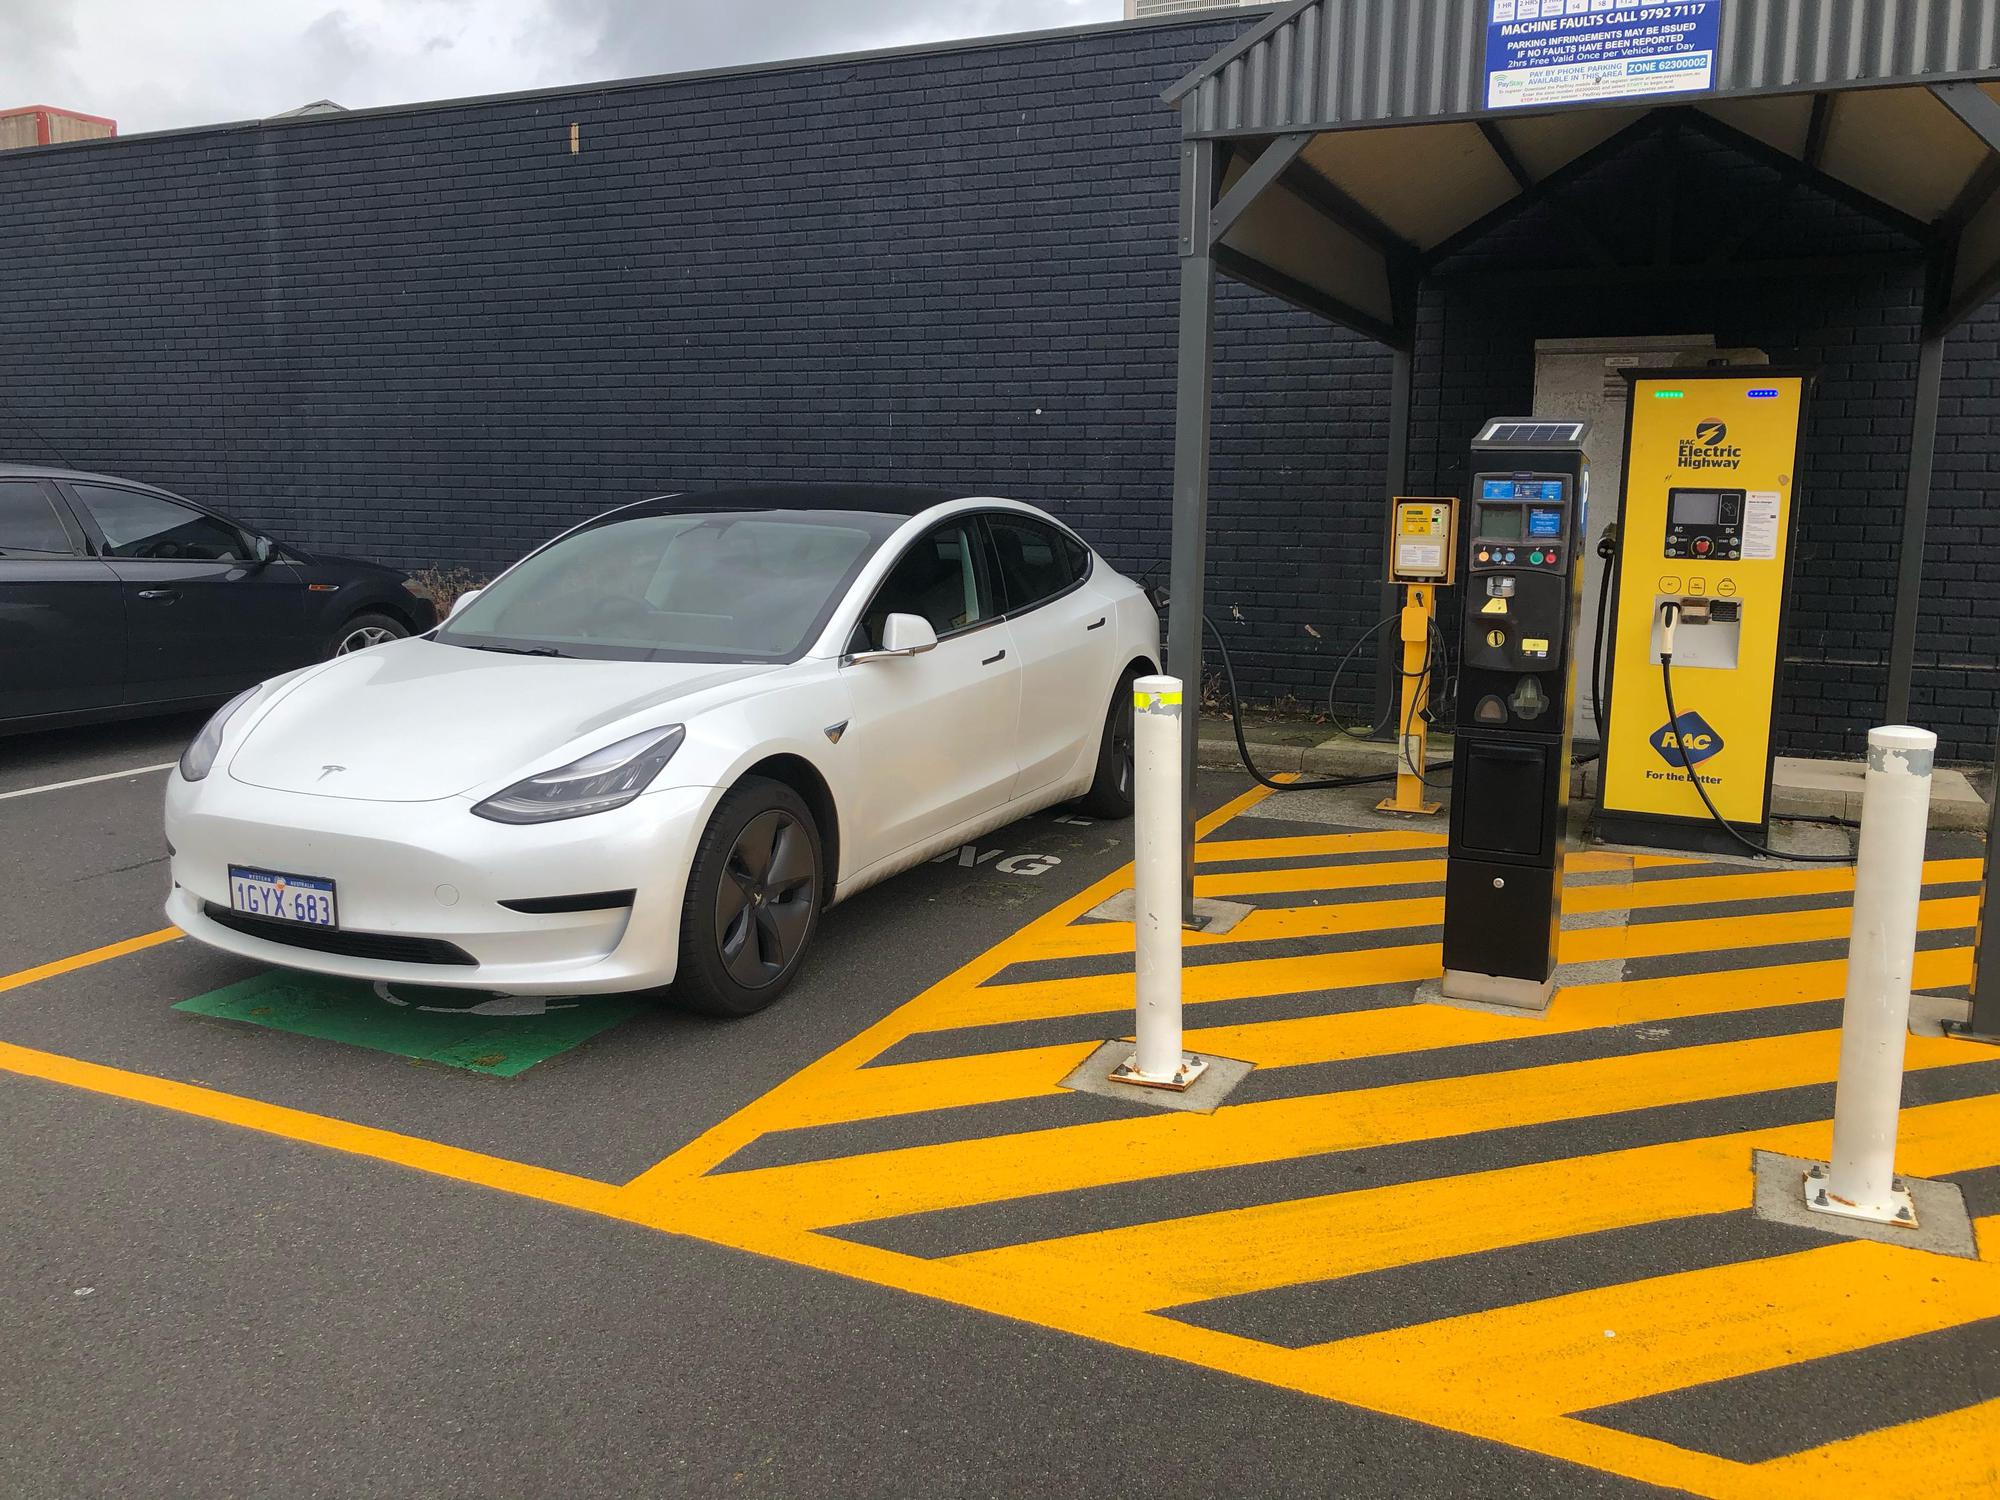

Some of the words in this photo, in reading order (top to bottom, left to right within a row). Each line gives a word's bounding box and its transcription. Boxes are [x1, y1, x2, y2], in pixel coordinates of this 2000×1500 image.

[1501, 20, 1557, 36] MACHINE
[1560, 14, 1603, 29] FAULTS
[1606, 11, 1637, 24] CALL
[1640, 7, 1671, 20] 9792
[1674, 3, 1706, 16] 7117
[1507, 38, 1546, 50] PARKING
[1549, 30, 1622, 45] INFRINGEMENTS
[1625, 28, 1645, 37] MAY
[1646, 26, 1659, 35] BE
[1661, 22, 1696, 33] ISSUED
[1517, 50, 1526, 58] IF
[1527, 48, 1541, 57] NO
[1543, 45, 1576, 56] FAULTS
[1578, 42, 1603, 52] HAVE
[1605, 39, 1630, 49] BEEN
[1632, 34, 1684, 46] REPORTED
[1508, 60, 1527, 68] 2hrs
[1530, 58, 1550, 66] Free
[1552, 54, 1574, 63] Valid
[1577, 52, 1600, 60] Once
[1603, 50, 1618, 59] per
[1621, 46, 1654, 56] Vehicle
[1657, 44, 1673, 53] per
[1676, 42, 1695, 51] Day
[1528, 76, 1568, 85] AVAILABLE
[1582, 72, 1600, 80] THIS
[1601, 70, 1622, 78] AREA
[1529, 70, 1543, 78] PAY
[1558, 66, 1584, 75] PHONE
[1587, 63, 1622, 72] PARKING
[1628, 62, 1656, 73] ZONE
[1679, 445, 1741, 457] Electric
[1678, 457, 1740, 470] Highway
[1661, 731, 1712, 750] RAC
[1646, 770, 1664, 780] For
[1666, 772, 1685, 782] the
[1686, 773, 1723, 785] btter
